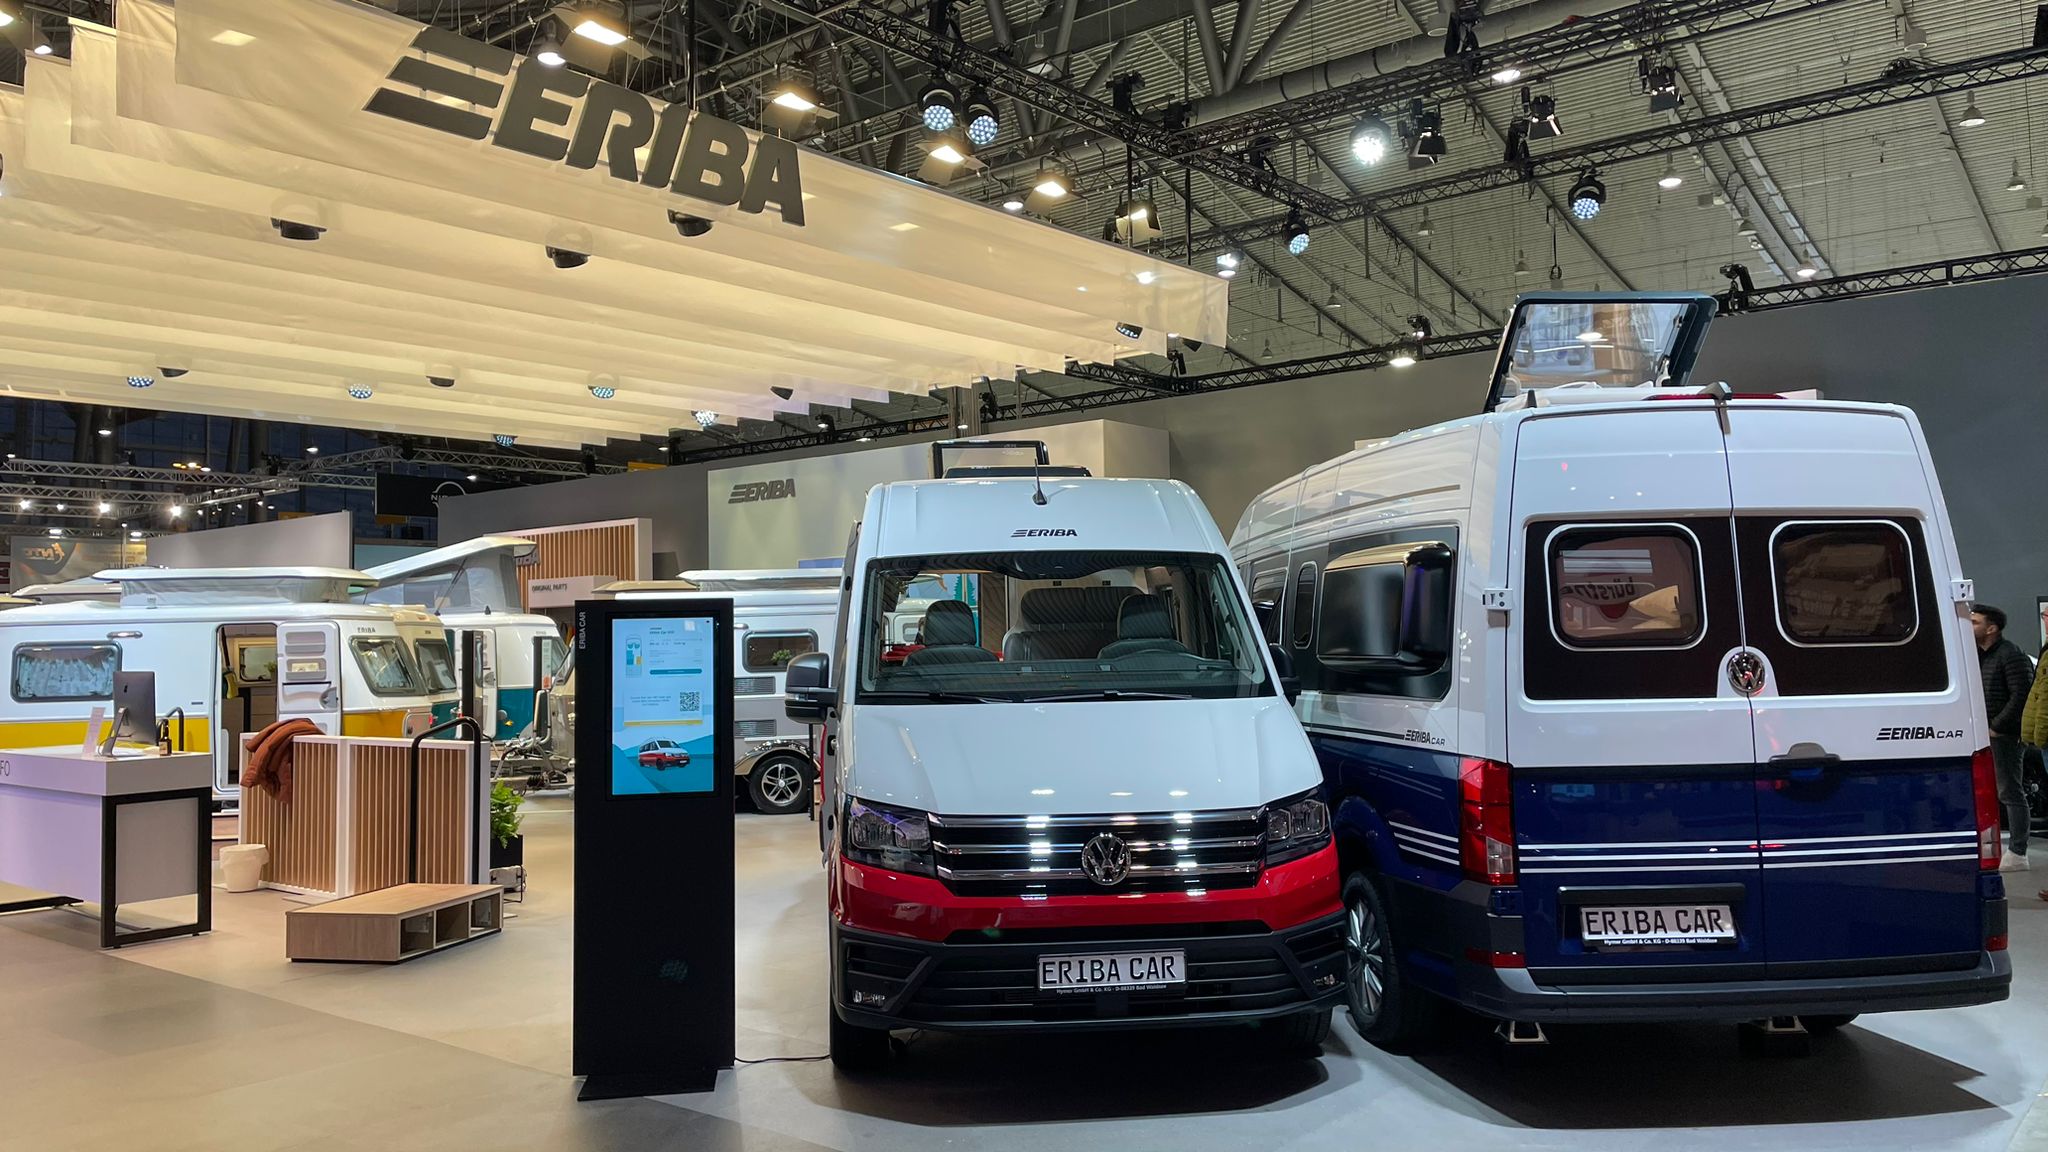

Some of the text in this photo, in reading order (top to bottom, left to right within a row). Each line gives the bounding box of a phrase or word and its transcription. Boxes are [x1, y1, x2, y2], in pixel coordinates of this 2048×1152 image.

[491, 57, 806, 227] ERIBA
[743, 478, 796, 502] ERIBA
[1027, 528, 1078, 537] ERIBA
[1411, 730, 1446, 746] ERIBA CAR
[1891, 727, 1964, 740] ERIBA CAR
[1585, 909, 1725, 935] ERIBA CAR
[1042, 956, 1176, 985] ERIBA CAR
